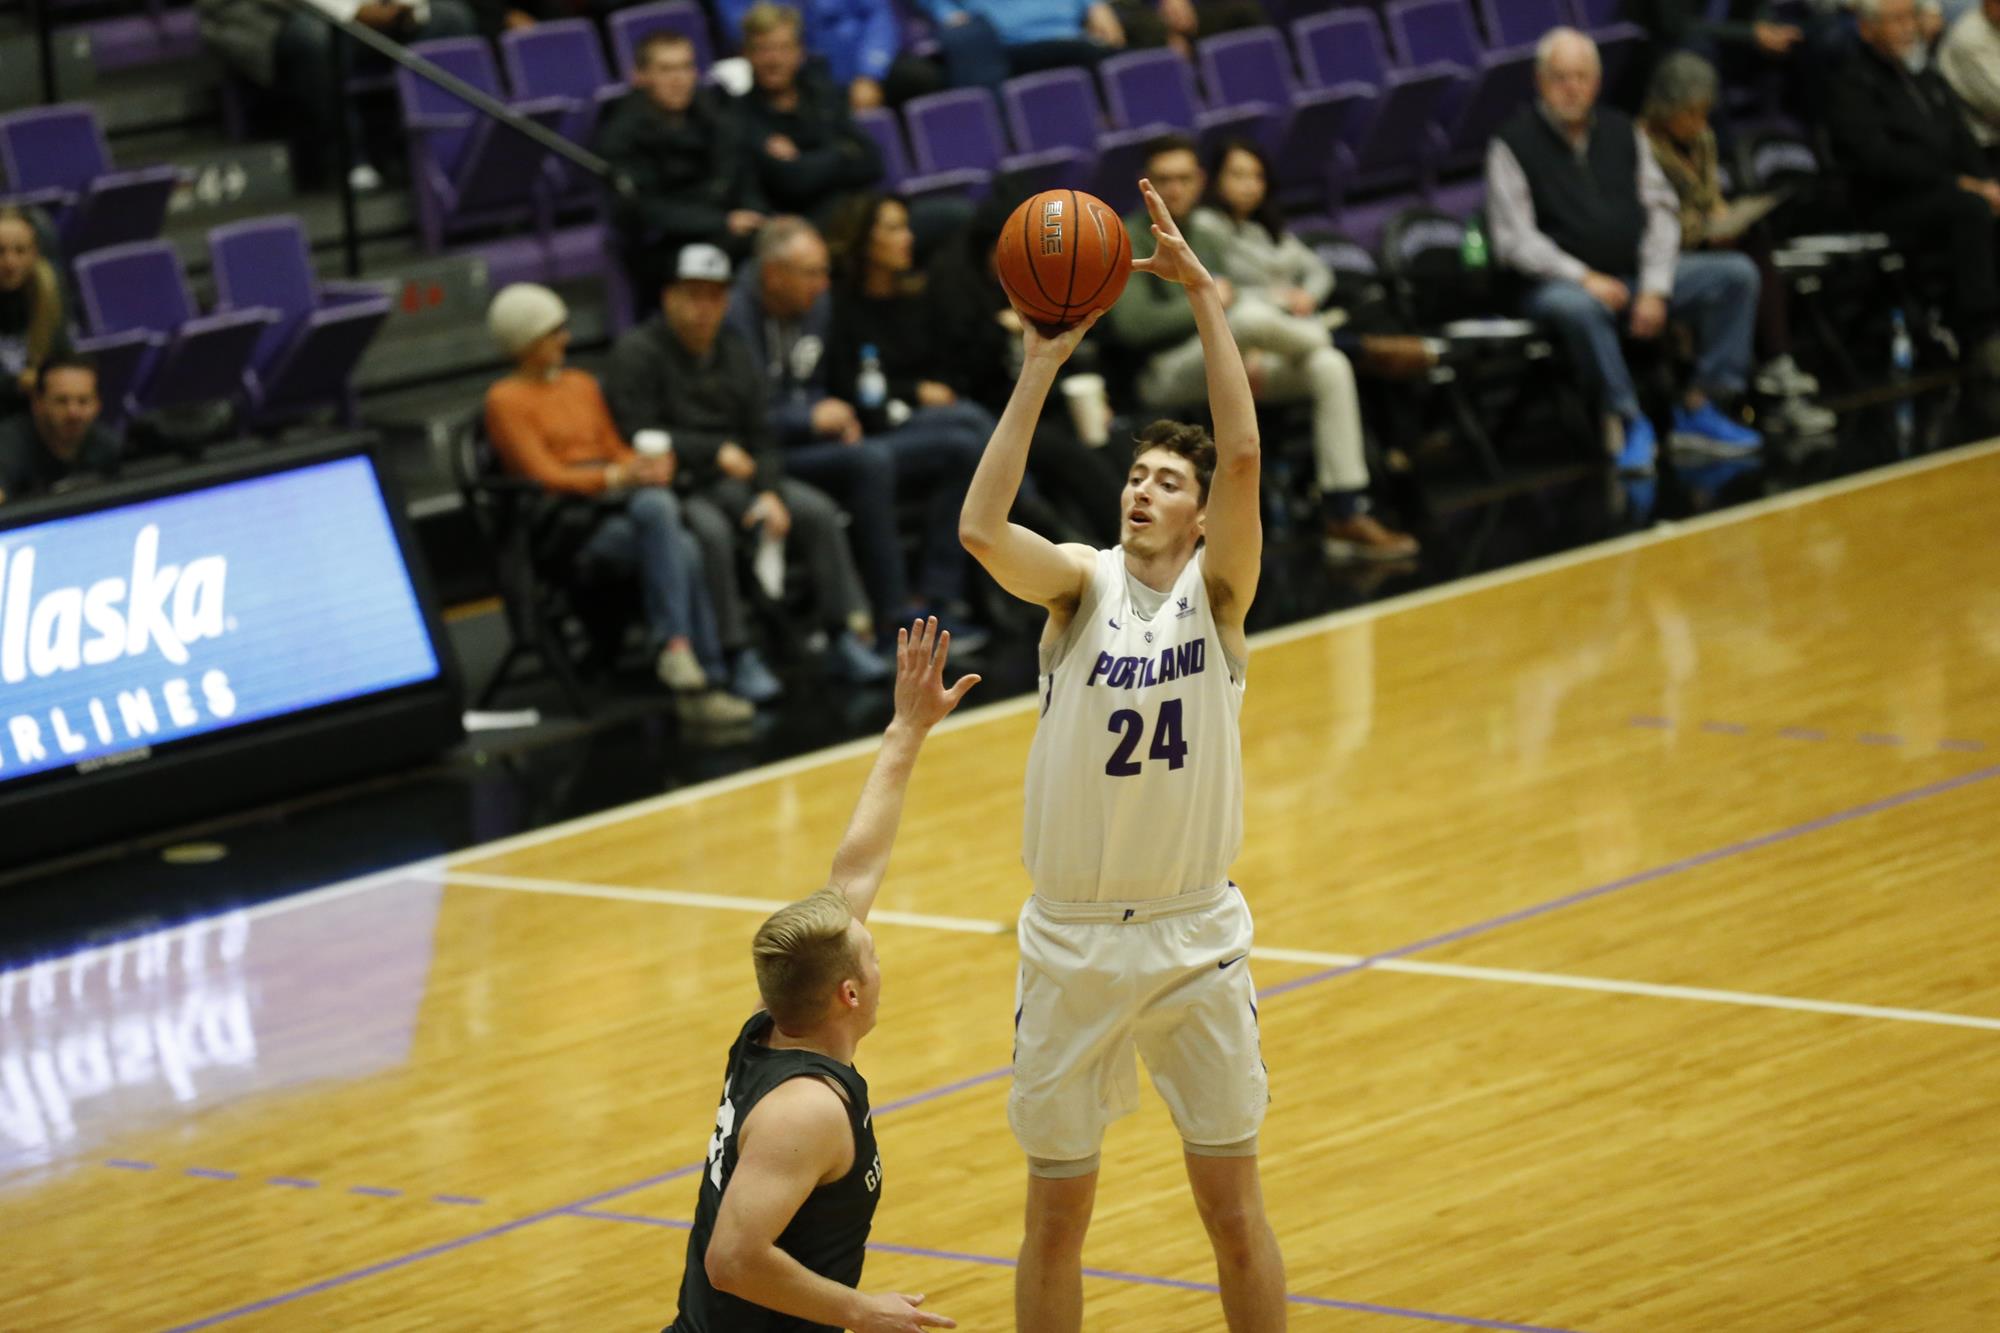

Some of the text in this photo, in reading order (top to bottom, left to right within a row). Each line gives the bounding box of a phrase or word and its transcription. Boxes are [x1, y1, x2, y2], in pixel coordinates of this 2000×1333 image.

[1045, 200, 1063, 256] ELITE
[0, 522, 228, 684] laska
[1086, 637, 1206, 690] PORTLAND
[0, 668, 237, 770] RLINES
[1105, 697, 1188, 777] 24
